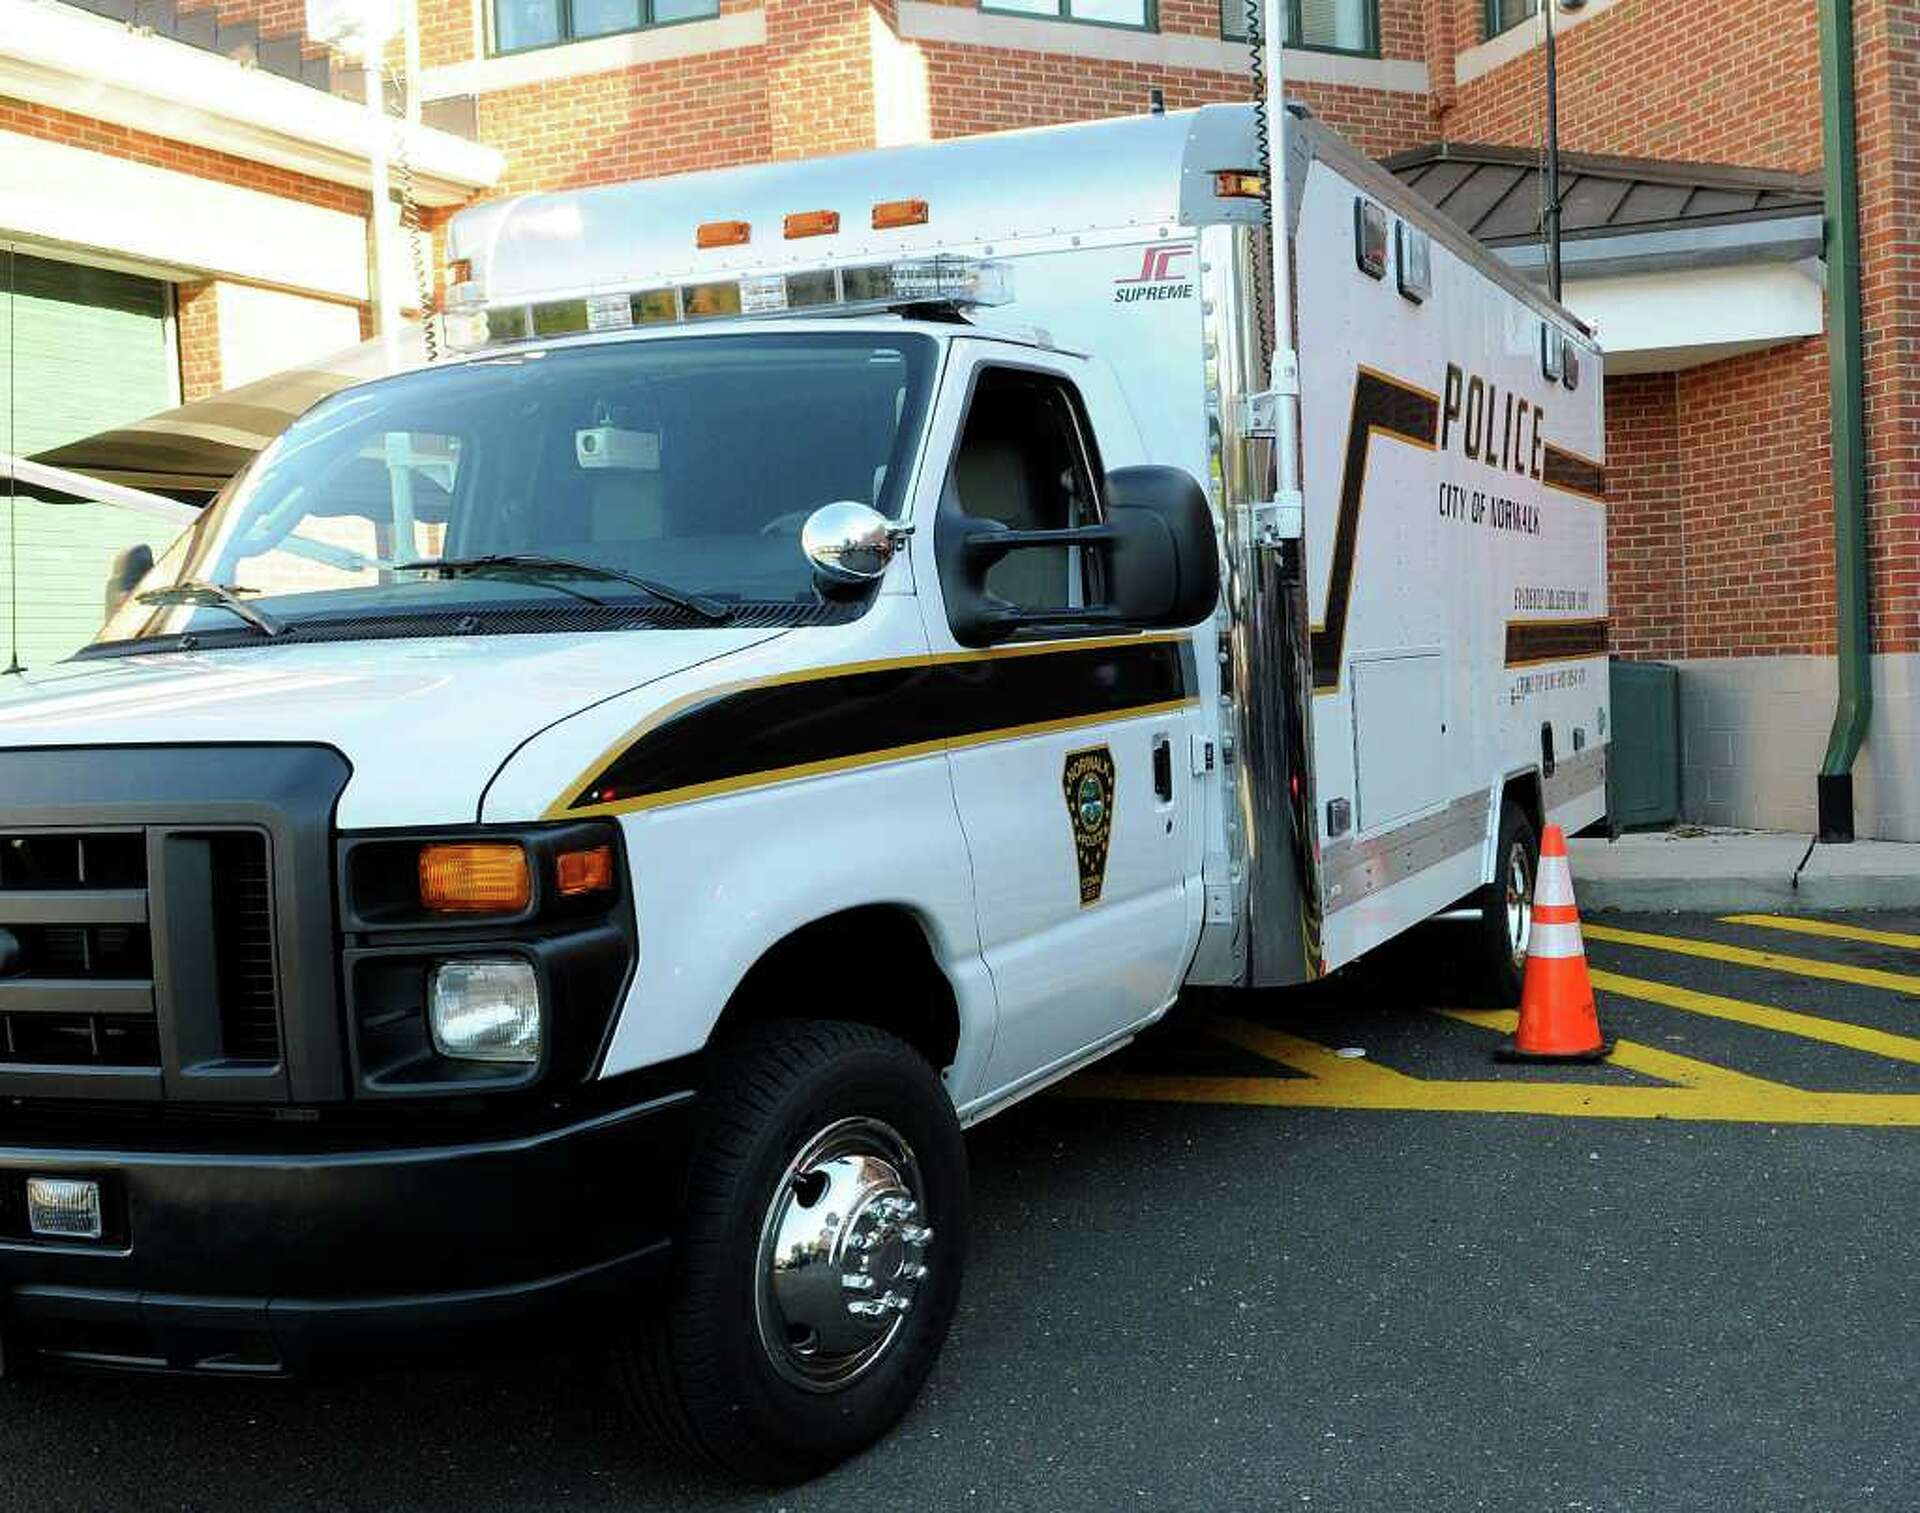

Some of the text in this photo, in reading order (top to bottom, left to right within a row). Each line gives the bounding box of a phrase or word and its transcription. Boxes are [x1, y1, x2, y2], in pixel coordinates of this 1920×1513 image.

[1115, 284, 1193, 303] SUPREME
[1441, 361, 1544, 481] POLICE
[1439, 482, 1540, 535] CITY OF NORWALK
